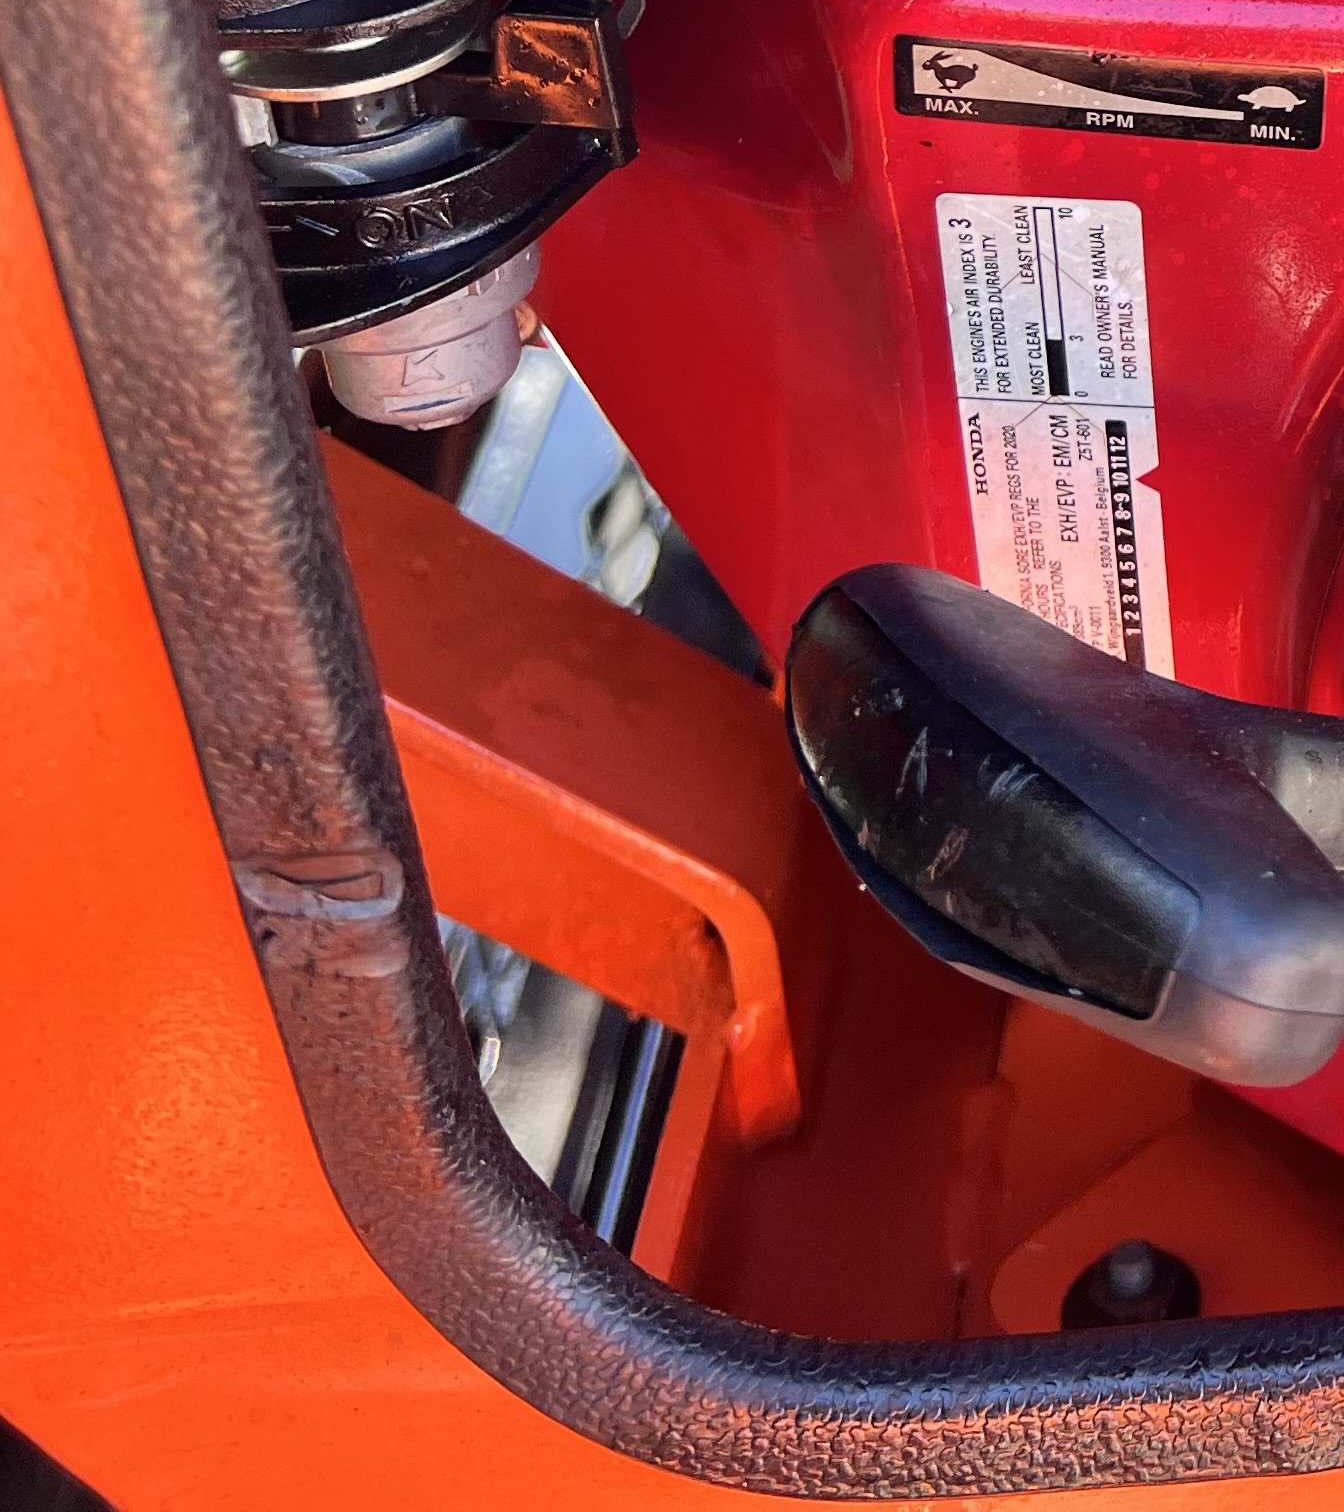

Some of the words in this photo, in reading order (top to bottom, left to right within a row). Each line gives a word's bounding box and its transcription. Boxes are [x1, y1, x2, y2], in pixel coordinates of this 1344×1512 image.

[925, 98, 979, 116] MAX.
[1085, 112, 1134, 129] RPM
[1250, 124, 1296, 141] MIN.
[949, 218, 971, 229] 3
[1014, 205, 1030, 244] CLEAN
[1058, 207, 1073, 219] 10
[959, 233, 973, 244] IS
[1089, 224, 1107, 280] MANUAL
[961, 248, 978, 284] INDEX
[1018, 247, 1035, 285] LEAST
[965, 288, 980, 307] AIR
[1093, 283, 1112, 341] OWNER'S
[967, 310, 986, 363] ENGINE'S
[989, 307, 1009, 367] EXTENDED
[1025, 321, 1042, 359] CLEAN
[1070, 334, 1084, 342] 3
[1098, 347, 1116, 379] READ
[1121, 356, 1138, 379] FOR
[974, 367, 990, 392] THIS
[997, 371, 1012, 394] FOR
[1029, 364, 1046, 396] MOST
[1049, 415, 1072, 467] EM/CM
[1076, 418, 1093, 461] Z5T-601
[968, 412, 989, 496] HONDA
[1005, 451, 1018, 471] FOR
[1007, 474, 1022, 500] REGS
[1095, 467, 1108, 510] Belgium
[1026, 497, 1040, 517] THE
[1011, 503, 1028, 546] EXH/EVP
[1028, 521, 1042, 534] TO
[1098, 517, 1110, 543] Aalst
[1030, 538, 1045, 570] REFER
[1100, 545, 1113, 568] 9300
